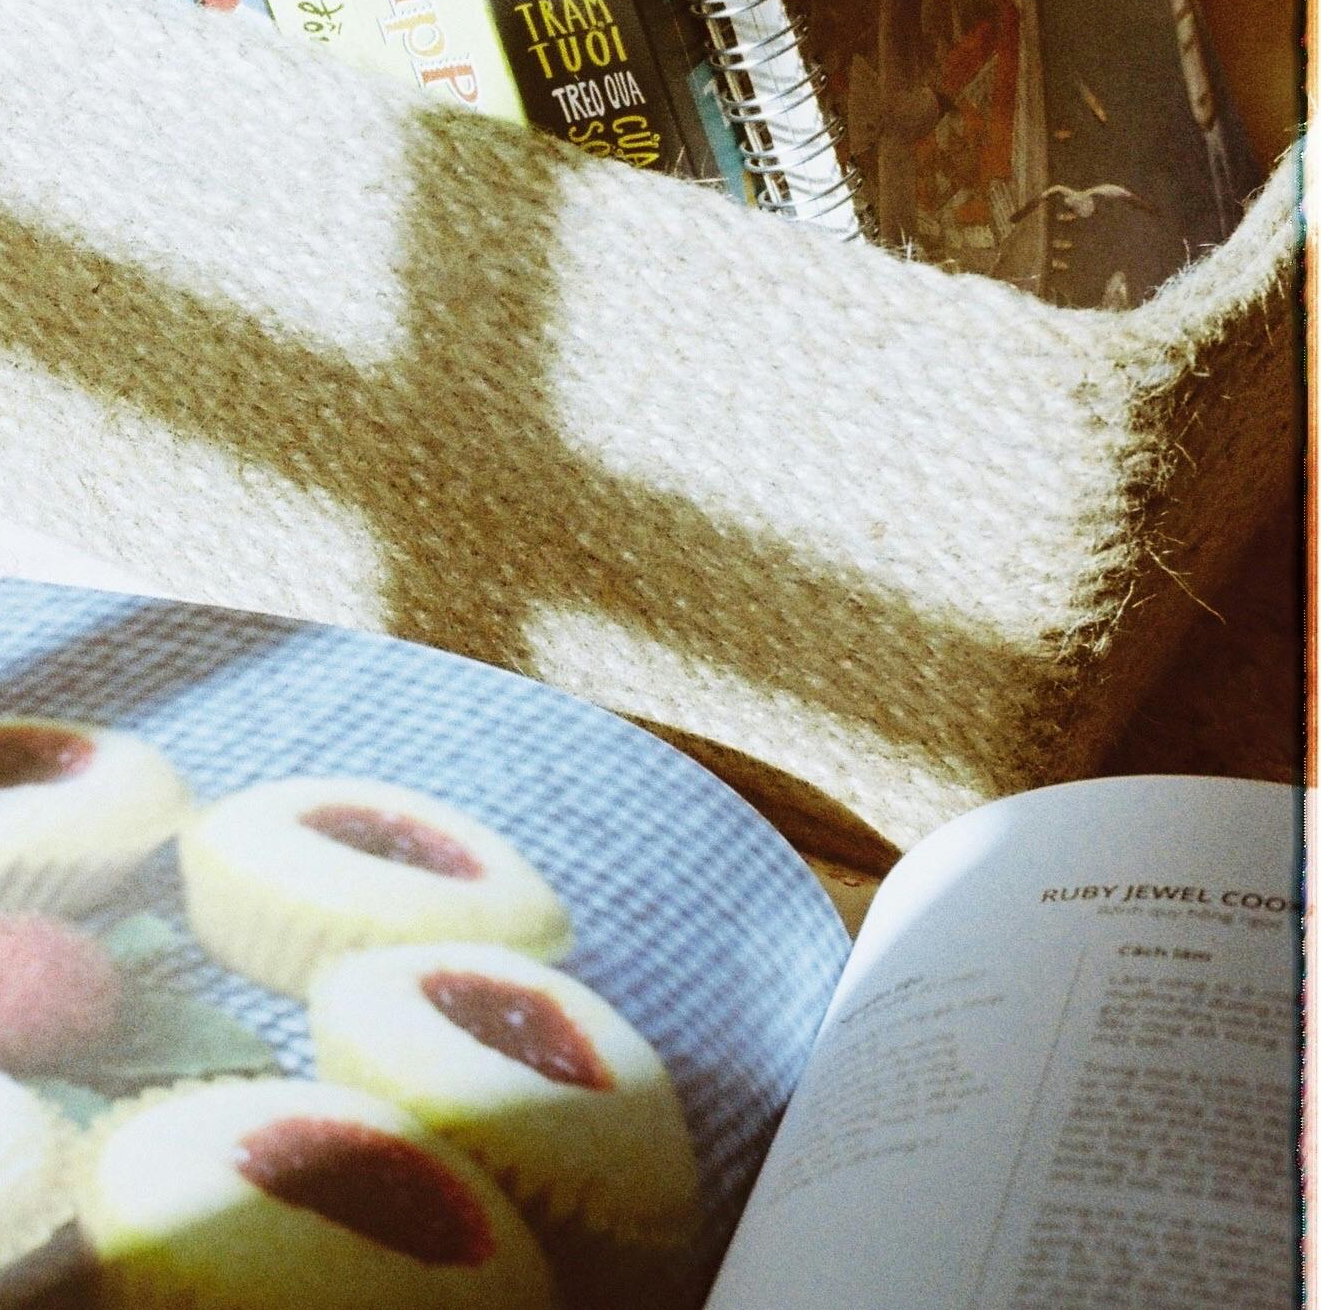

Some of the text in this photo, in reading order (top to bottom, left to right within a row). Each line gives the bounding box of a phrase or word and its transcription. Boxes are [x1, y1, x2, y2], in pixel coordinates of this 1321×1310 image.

[604, 70, 647, 110] QUA
[1041, 884, 1119, 903] RUBY
[1123, 884, 1212, 903] JEWEL
